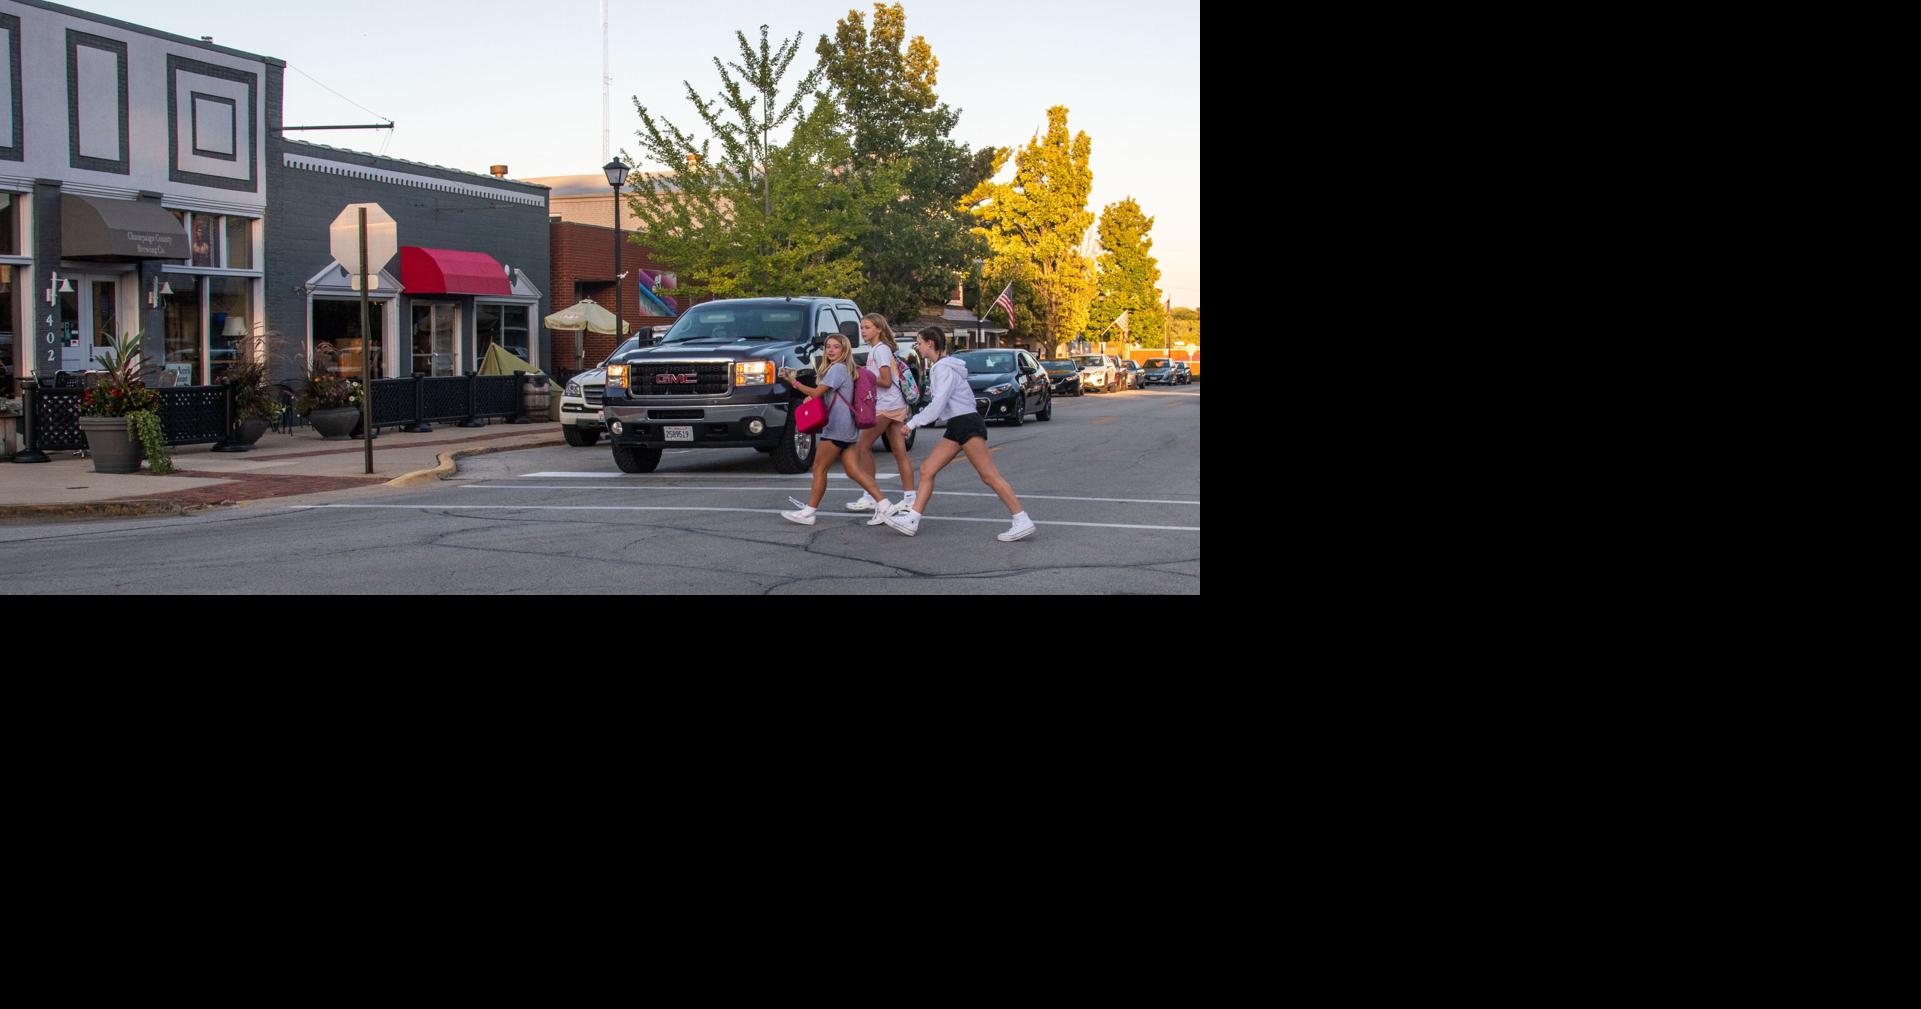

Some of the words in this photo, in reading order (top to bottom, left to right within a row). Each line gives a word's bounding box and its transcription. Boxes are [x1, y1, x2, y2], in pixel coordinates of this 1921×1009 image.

[155, 233, 173, 246] County
[46, 314, 56, 361] 402
[656, 374, 697, 384] GMC
